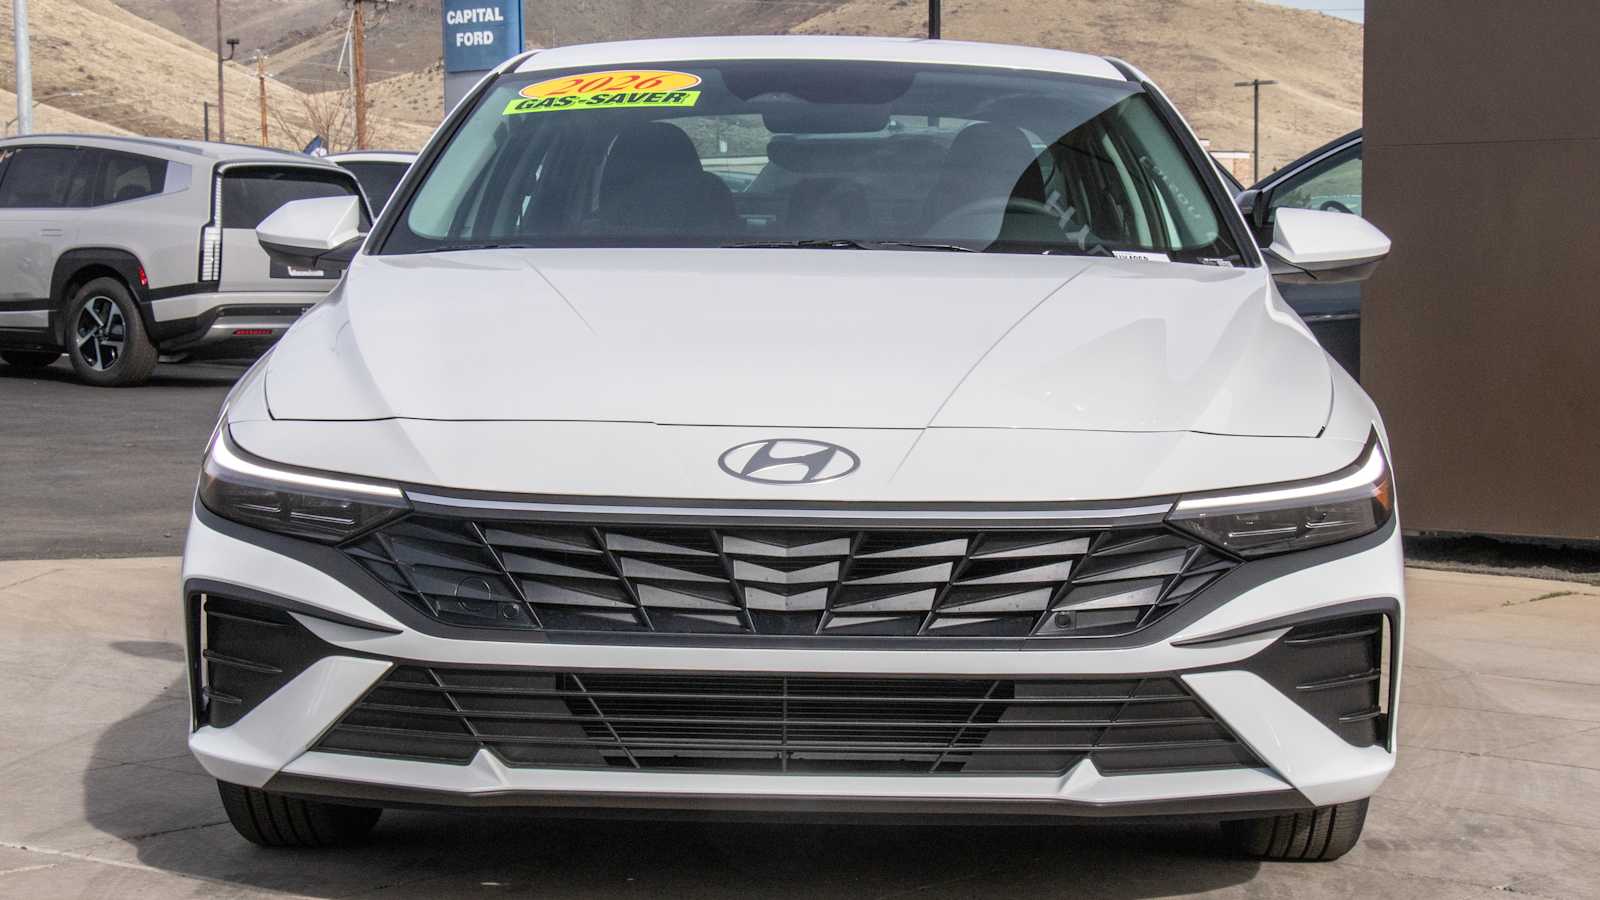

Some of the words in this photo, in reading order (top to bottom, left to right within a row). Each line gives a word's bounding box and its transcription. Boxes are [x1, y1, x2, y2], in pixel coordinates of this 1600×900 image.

[446, 7, 504, 25] CAPITAL
[456, 30, 494, 47] FORD
[550, 75, 664, 95] 2026
[515, 91, 685, 110] GAS-SAVER
